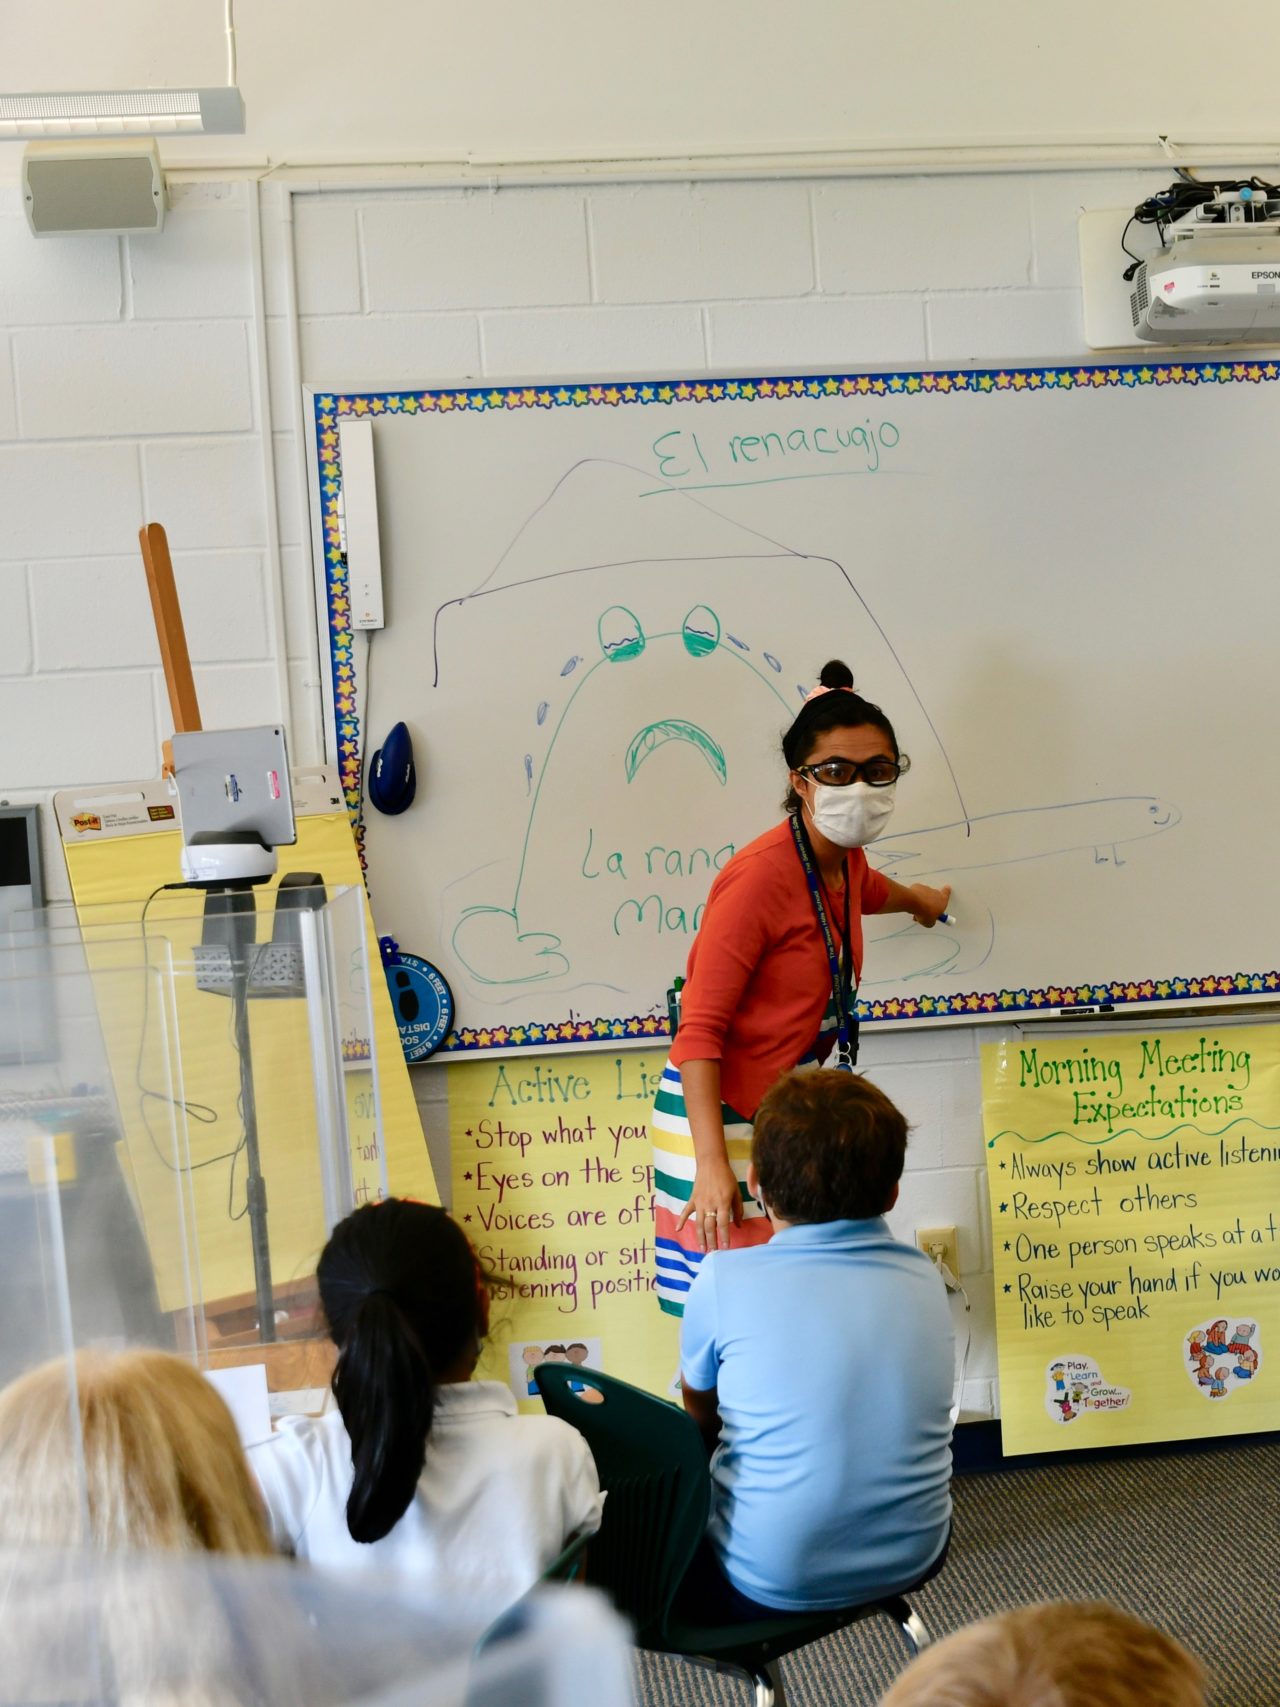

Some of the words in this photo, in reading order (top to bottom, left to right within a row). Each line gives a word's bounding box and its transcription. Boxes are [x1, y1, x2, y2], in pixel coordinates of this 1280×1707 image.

[1251, 271, 1280, 280] EPSON
[653, 431, 709, 477] El
[729, 418, 899, 472] renacuajo
[582, 828, 628, 880] La
[488, 1065, 592, 1107] Active
[1019, 1048, 1123, 1099] Morning
[1138, 1037, 1251, 1091] Meeting
[1072, 1084, 1244, 1134] Expectations
[476, 1118, 533, 1158] Stop
[542, 1115, 597, 1145] what
[608, 1124, 648, 1158] you
[477, 1161, 534, 1204] Eyes
[542, 1168, 570, 1187] on
[579, 1156, 623, 1184] the
[1011, 1152, 1077, 1190] Always
[1084, 1149, 1137, 1176] show
[1148, 1141, 1212, 1170] active
[476, 1203, 555, 1231] Voices
[567, 1209, 608, 1227] are
[1012, 1186, 1103, 1229] Respect
[1119, 1183, 1198, 1212] others
[478, 1244, 577, 1285] Standing
[585, 1250, 609, 1266] or
[1015, 1232, 1060, 1264] One
[1069, 1237, 1137, 1269] person
[1143, 1223, 1218, 1258] speaks
[1223, 1218, 1244, 1245] at
[1251, 1228, 1263, 1243] a
[1018, 1272, 1073, 1305] Raise
[1078, 1280, 1122, 1309] your
[1129, 1266, 1178, 1296] hand
[1185, 1261, 1202, 1292] if
[1210, 1268, 1248, 1301] you
[1023, 1302, 1056, 1330] like
[1063, 1302, 1085, 1326] to
[1092, 1296, 1151, 1331] speak
[1070, 1371, 1099, 1381] Learn
[1083, 1394, 1130, 1409] Together!
